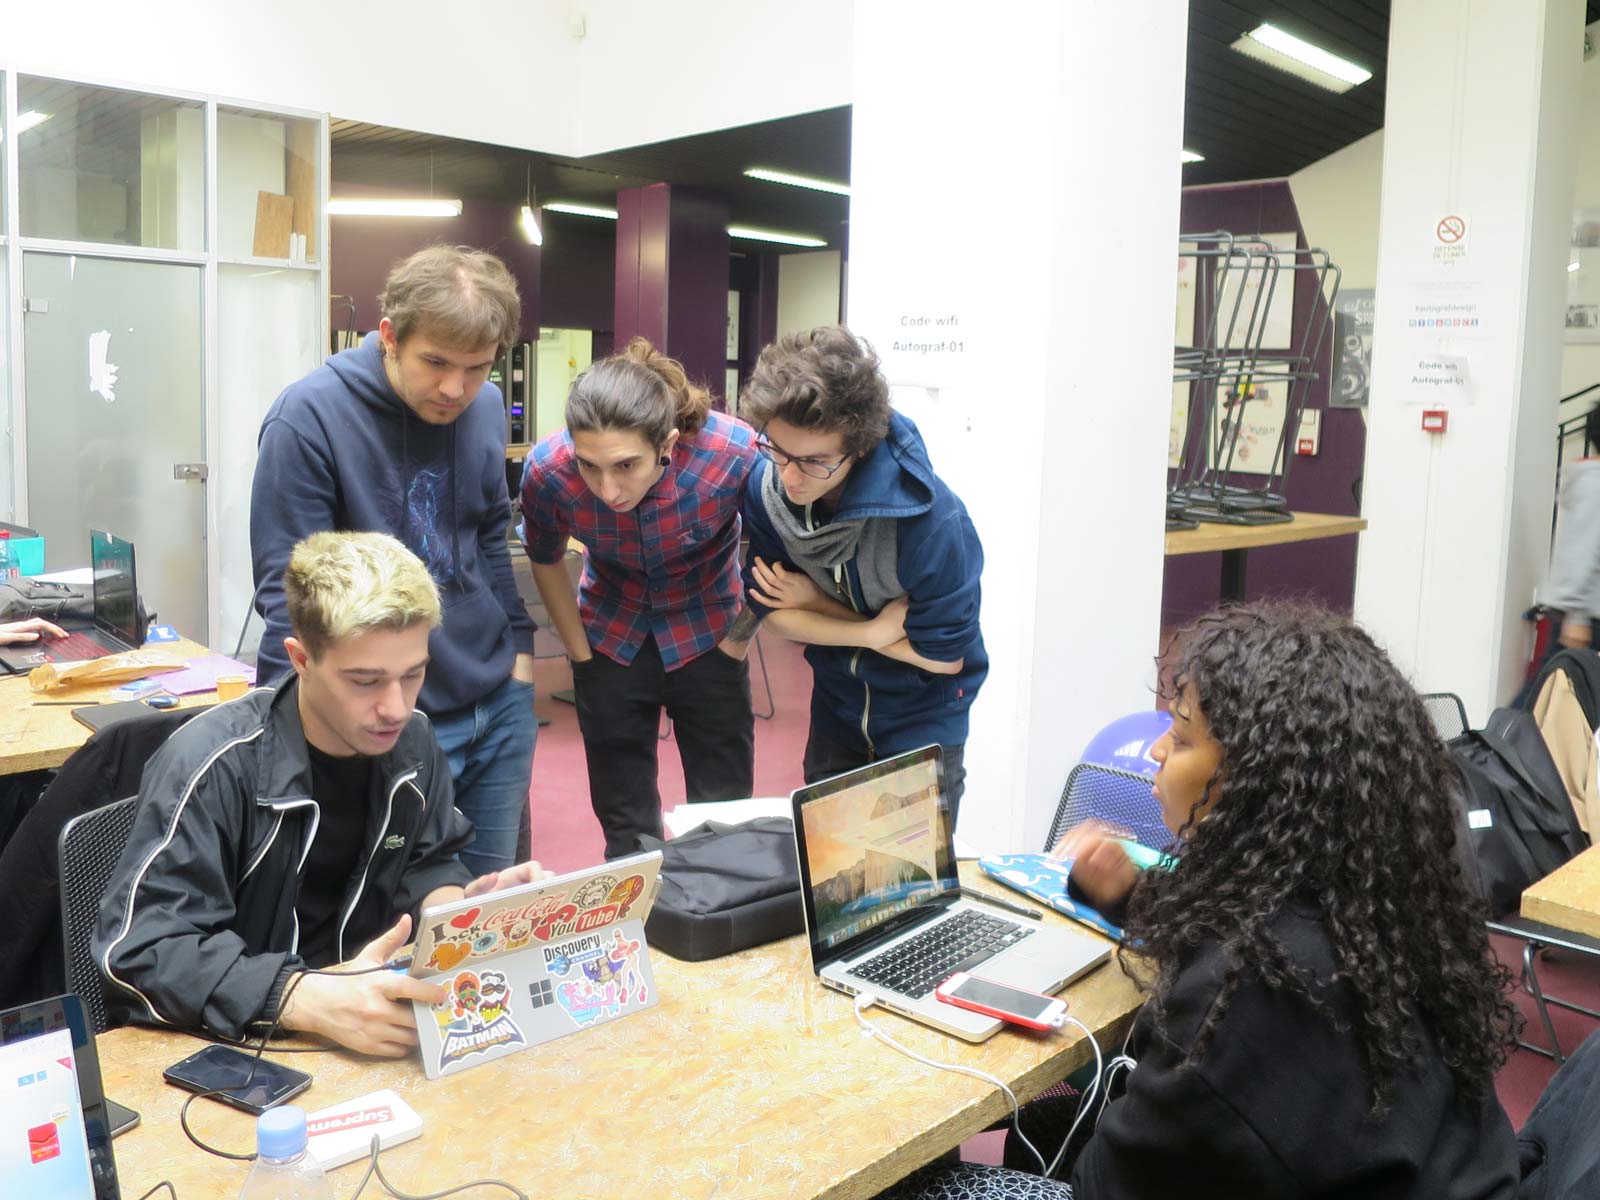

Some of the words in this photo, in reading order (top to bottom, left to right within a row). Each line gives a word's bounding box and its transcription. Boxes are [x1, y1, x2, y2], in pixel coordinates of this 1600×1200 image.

[900, 315, 931, 327] Code
[936, 314, 958, 326] wifi
[893, 341, 964, 354] Autograf-01
[444, 1019, 518, 1057] BATMAN
[306, 1109, 390, 1134] Suprem
